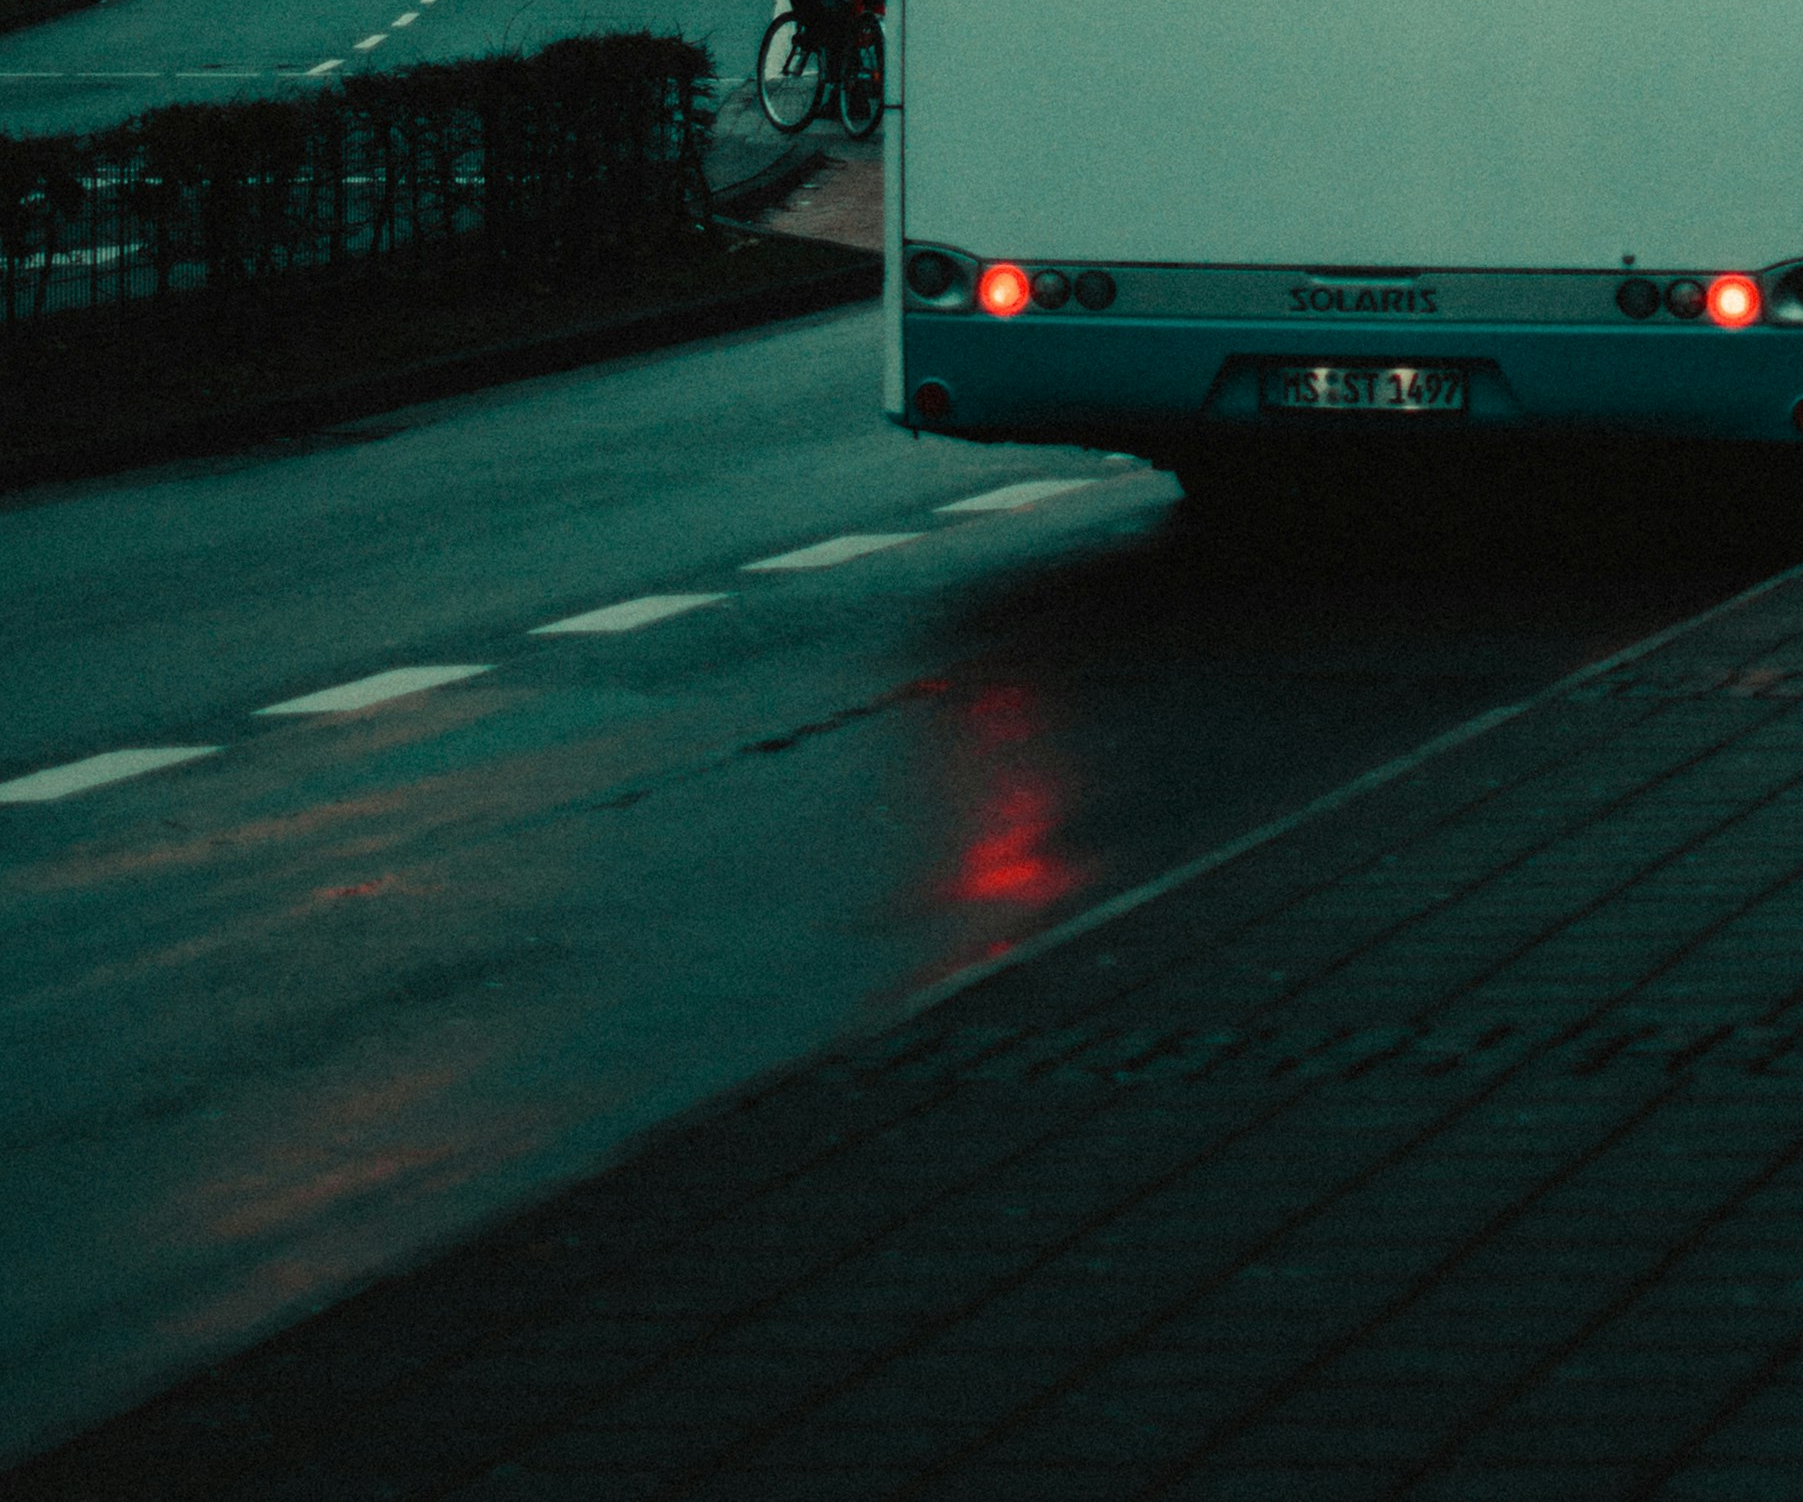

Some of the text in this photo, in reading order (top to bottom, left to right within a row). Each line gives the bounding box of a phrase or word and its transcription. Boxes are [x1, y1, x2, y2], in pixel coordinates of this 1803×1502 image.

[1290, 287, 1437, 314] SOLARIS
[1281, 370, 1460, 405] MS ST 1497
